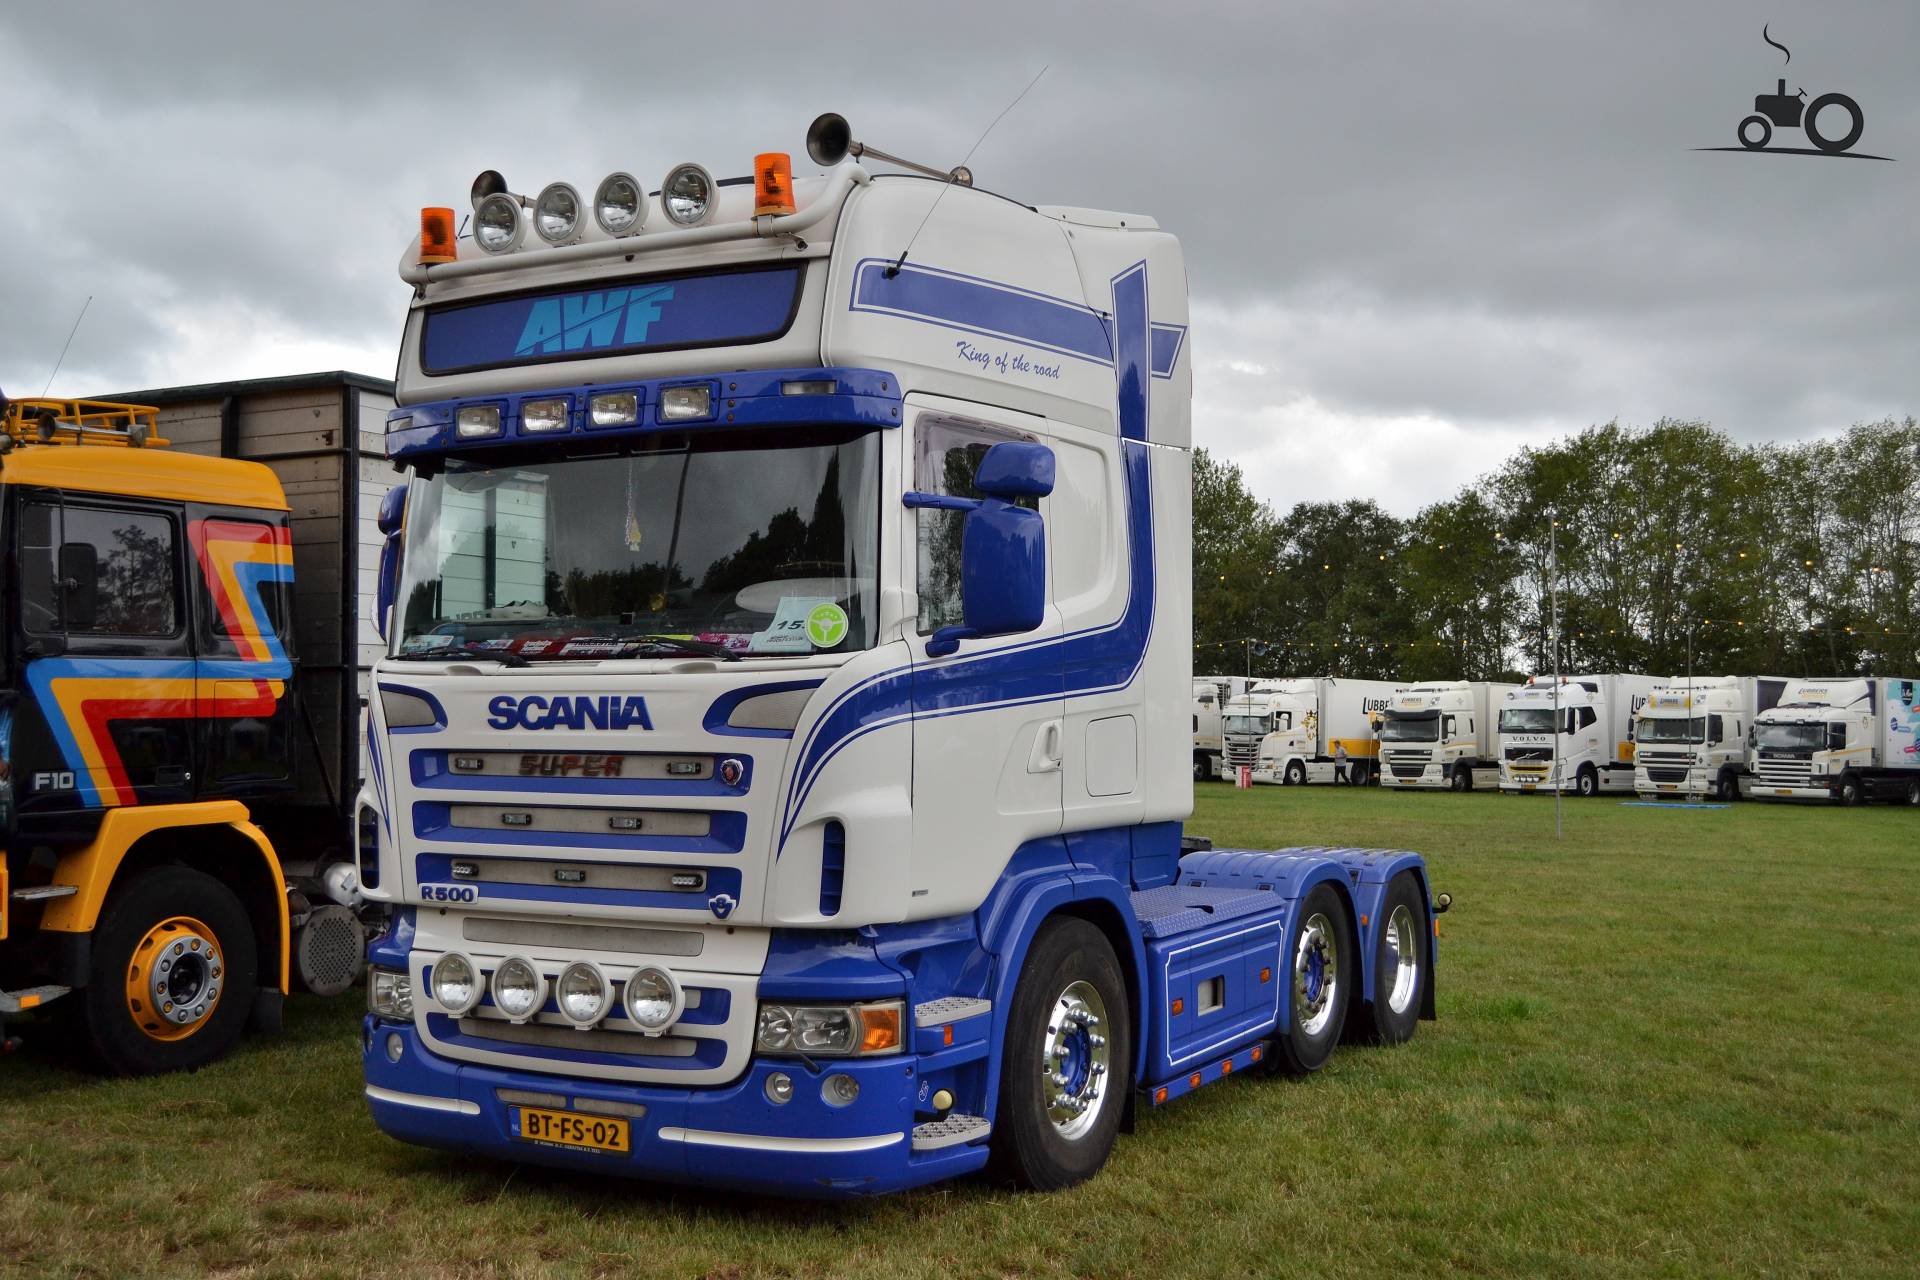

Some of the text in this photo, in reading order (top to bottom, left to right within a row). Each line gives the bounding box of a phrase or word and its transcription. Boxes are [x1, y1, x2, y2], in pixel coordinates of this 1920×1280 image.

[514, 285, 675, 357] AWF
[956, 341, 1061, 379] King of the road
[487, 695, 654, 731] SCANIA
[35, 772, 75, 790] F10
[519, 754, 625, 777] SUPER
[512, 1123, 521, 1132] NL
[528, 1112, 621, 1147] BT-FS-02
